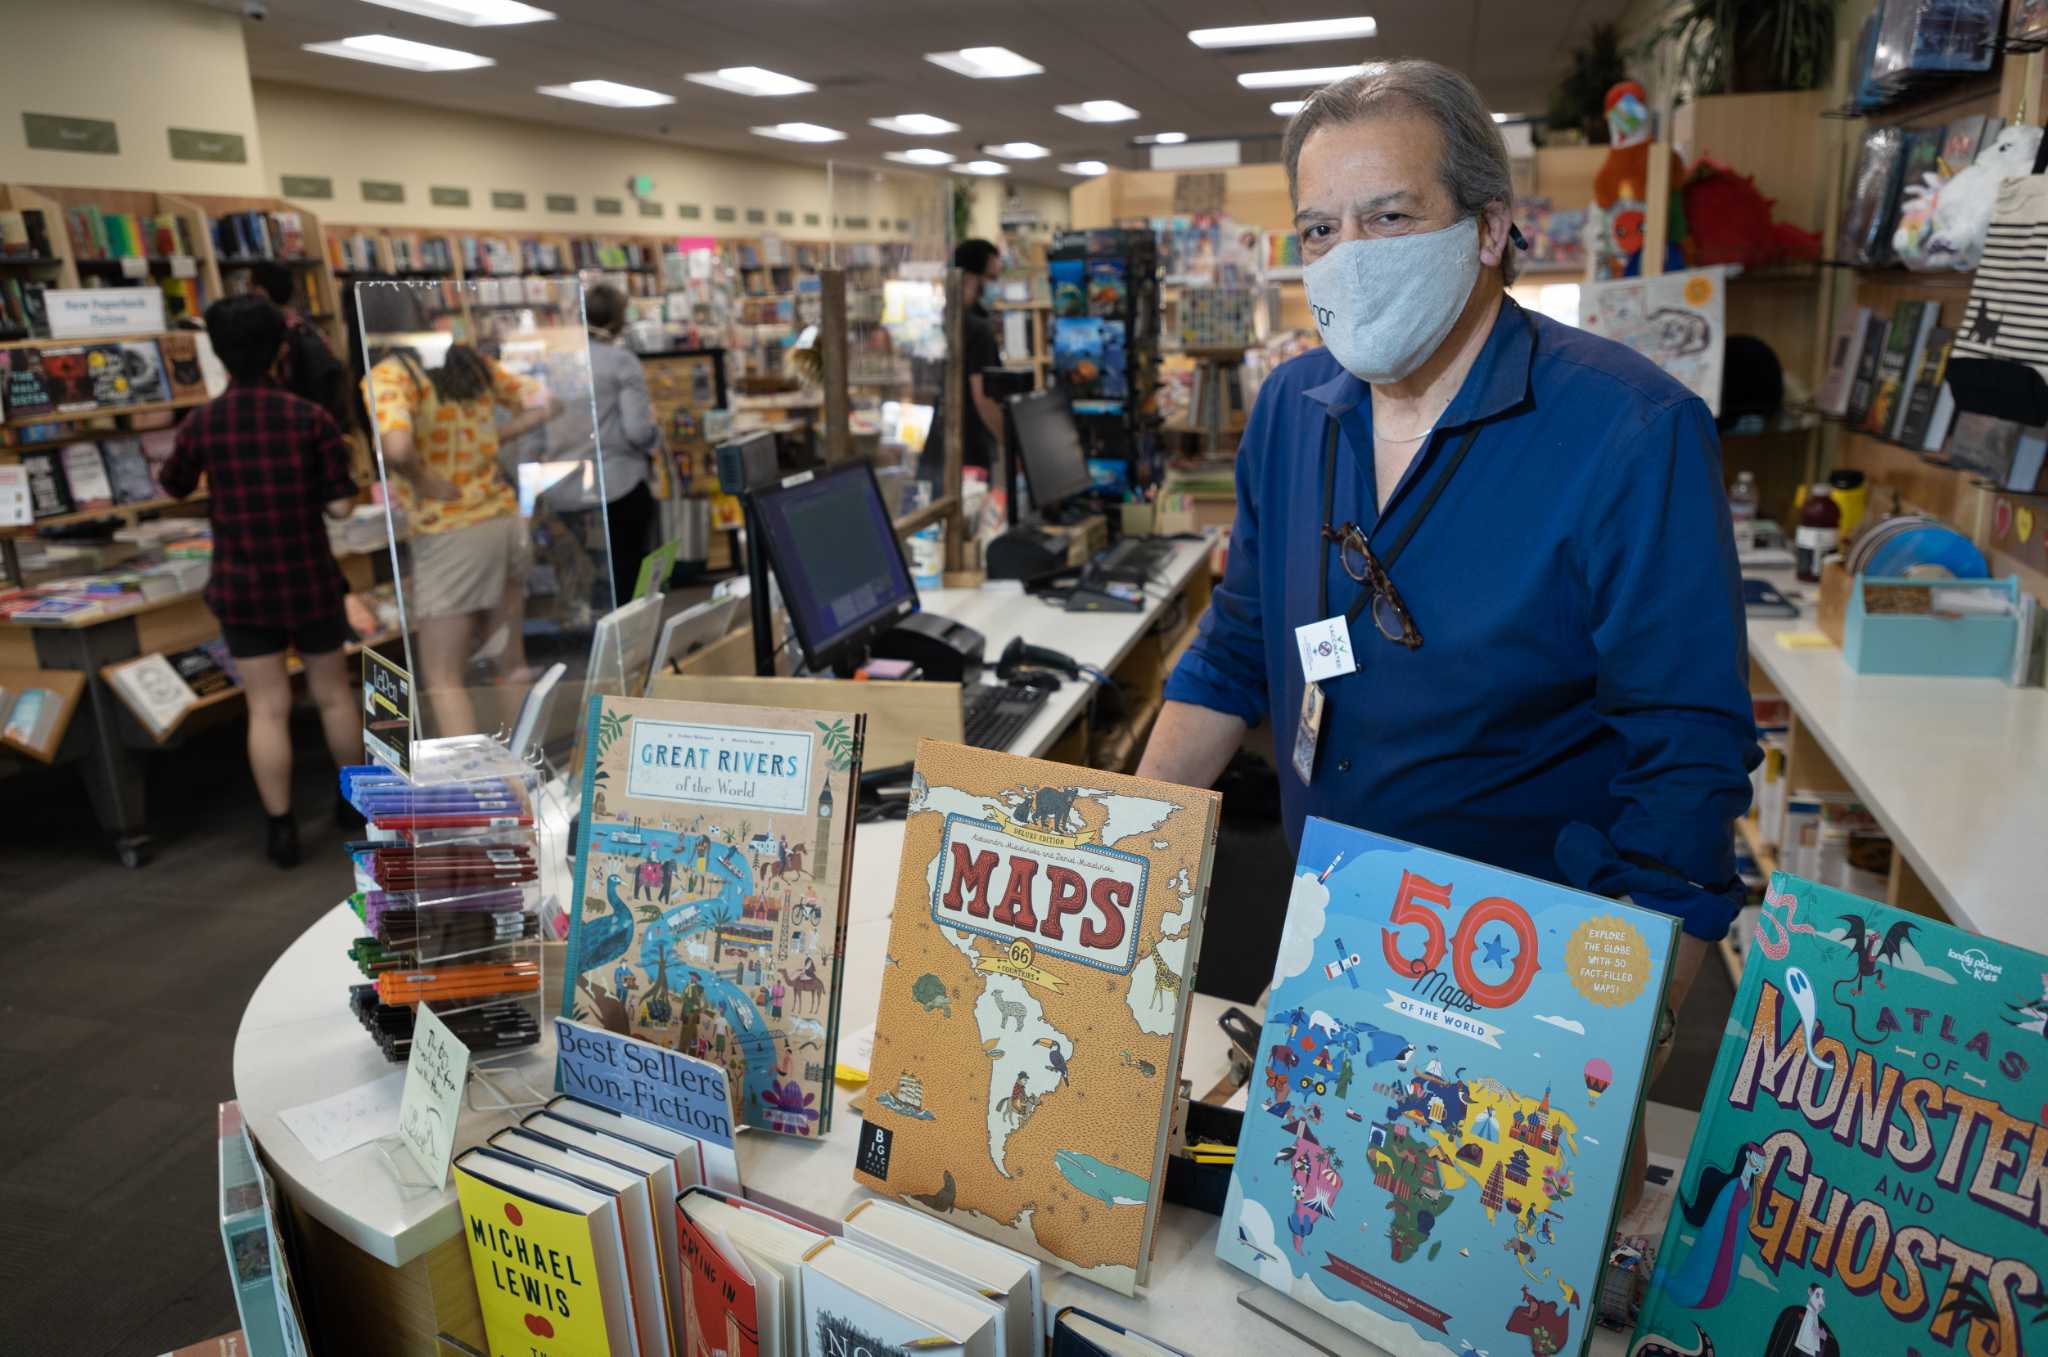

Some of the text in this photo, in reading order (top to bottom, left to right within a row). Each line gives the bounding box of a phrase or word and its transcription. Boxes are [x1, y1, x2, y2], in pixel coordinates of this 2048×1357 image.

[641, 743, 799, 778] GREAT RIVERS
[675, 775, 756, 799] of the World
[1014, 827, 1038, 841] DELUXE
[1039, 833, 1065, 846] EDITION
[943, 841, 1134, 950] MAPS
[1381, 869, 1542, 1009] 50
[1584, 941, 1632, 954] THE GLOBE
[1589, 929, 1626, 941] EXPLORE
[1011, 946, 1030, 963] 66
[1588, 955, 1626, 968] WITH 50
[1947, 948, 2002, 975] lonely planet
[1001, 965, 1035, 980] COUNTRIES
[1411, 959, 1482, 1012] Maps
[1580, 967, 1633, 982] FACT-FILLED
[1400, 1001, 1485, 1036] OF THE WORLD
[1876, 1005, 2029, 1082] ATLAS
[557, 1023, 727, 1102] Best Sellers
[1922, 1052, 1960, 1078] OF
[561, 1057, 732, 1138] Non-Fiction
[1875, 1178, 1934, 1214] AND
[470, 1214, 582, 1286] MICHAEL
[1747, 1129, 2045, 1357] GHOSTS
[681, 1228, 736, 1301] CRYING IN
[492, 1260, 571, 1318] LEWIS
